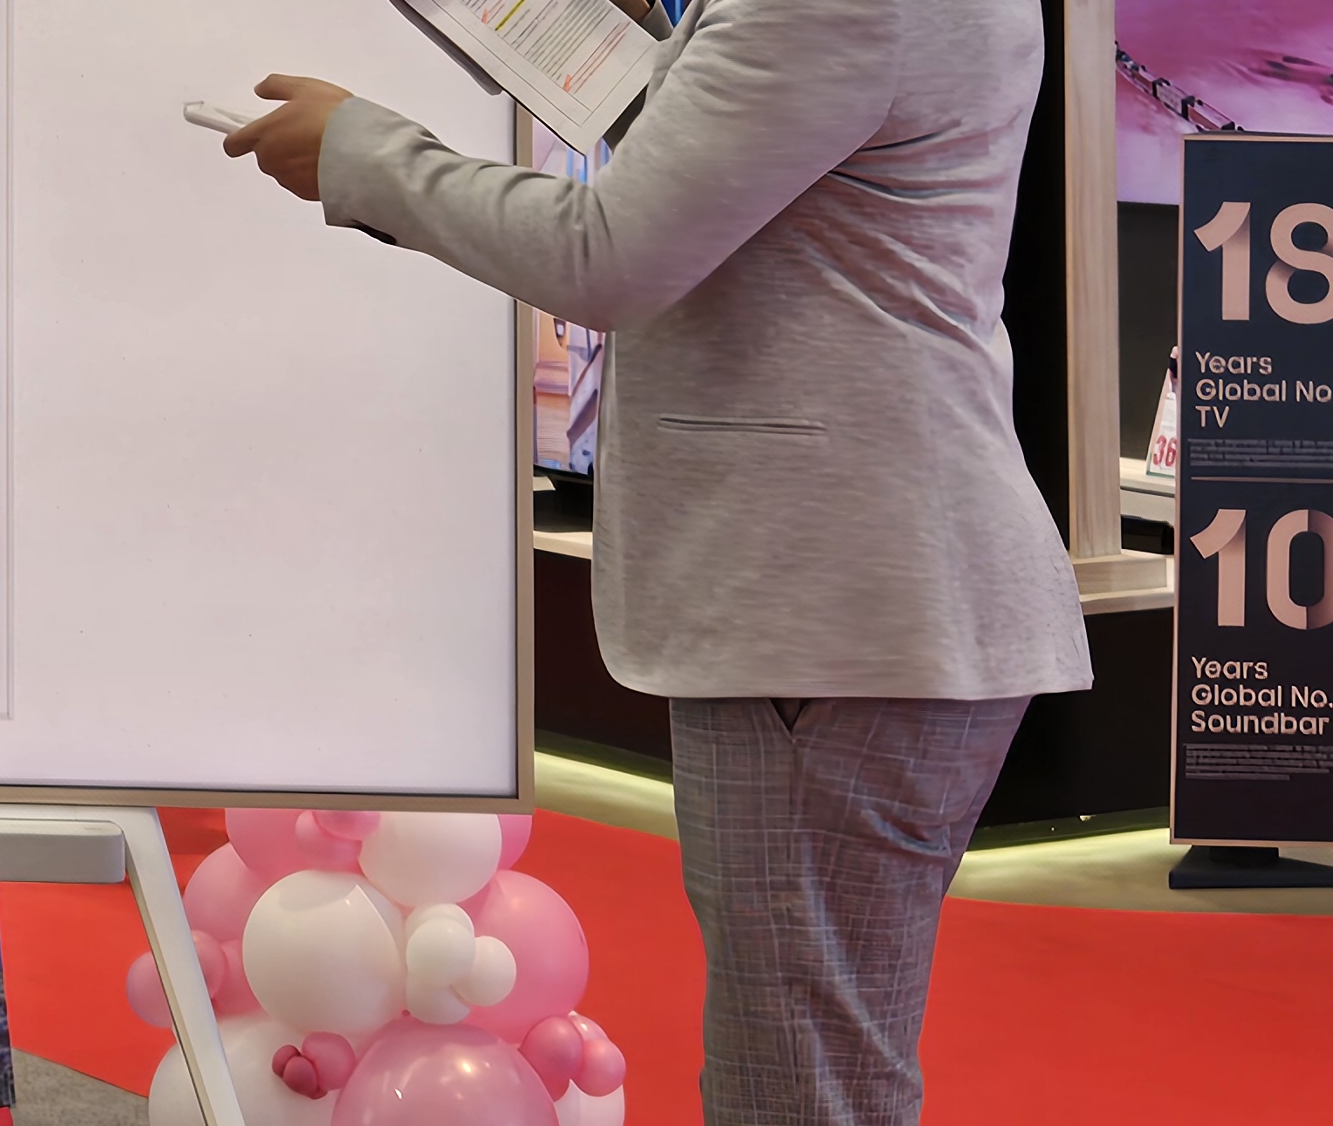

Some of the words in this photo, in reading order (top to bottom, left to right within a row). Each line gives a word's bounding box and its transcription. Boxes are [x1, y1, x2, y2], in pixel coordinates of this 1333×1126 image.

[1193, 200, 1333, 325] 18
[1195, 351, 1272, 375] Years
[1195, 378, 1286, 402] Global
[1195, 405, 1230, 428] TV
[1190, 508, 1333, 630] 10
[1191, 657, 1268, 680] Years
[1191, 684, 1282, 707] Global
[1191, 710, 1330, 735] Soundbar
